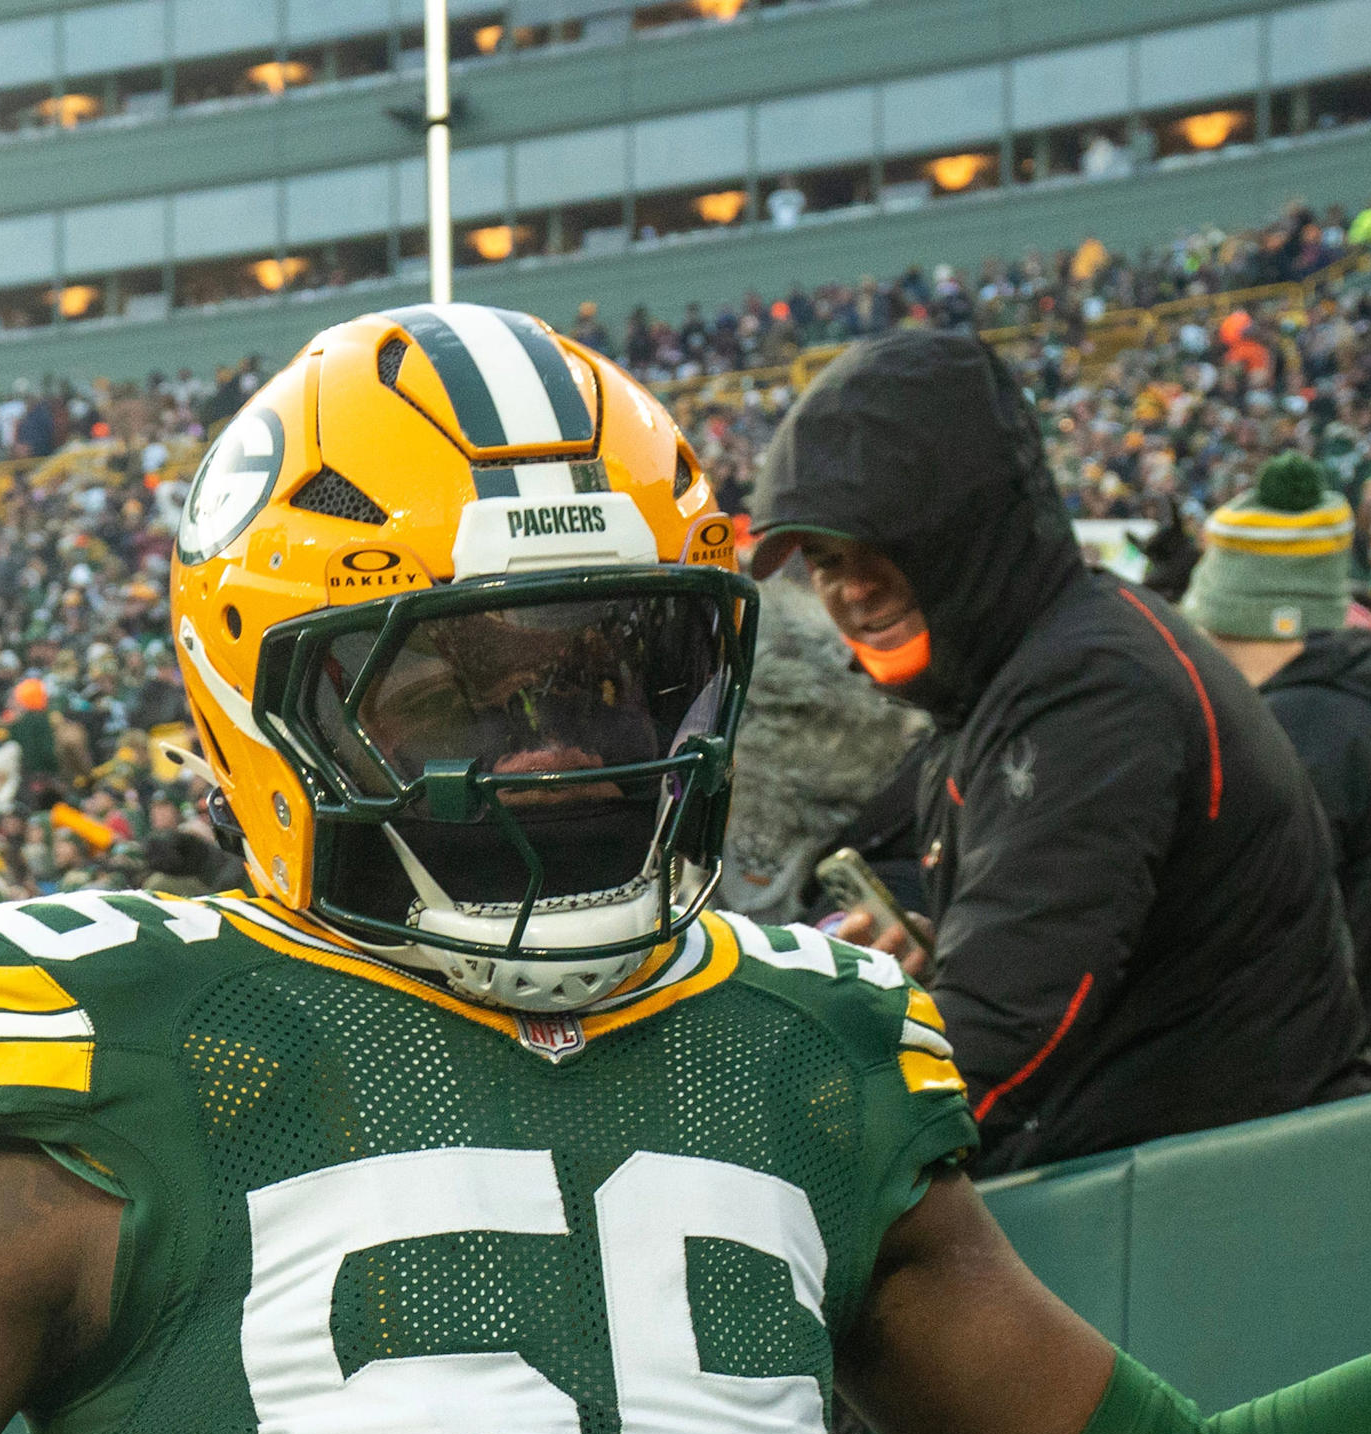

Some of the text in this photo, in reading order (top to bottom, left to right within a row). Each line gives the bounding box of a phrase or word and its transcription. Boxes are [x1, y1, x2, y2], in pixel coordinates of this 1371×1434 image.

[507, 505, 606, 538] PACKERS
[330, 573, 417, 588] OAKLEY
[529, 1021, 575, 1047] NFL
